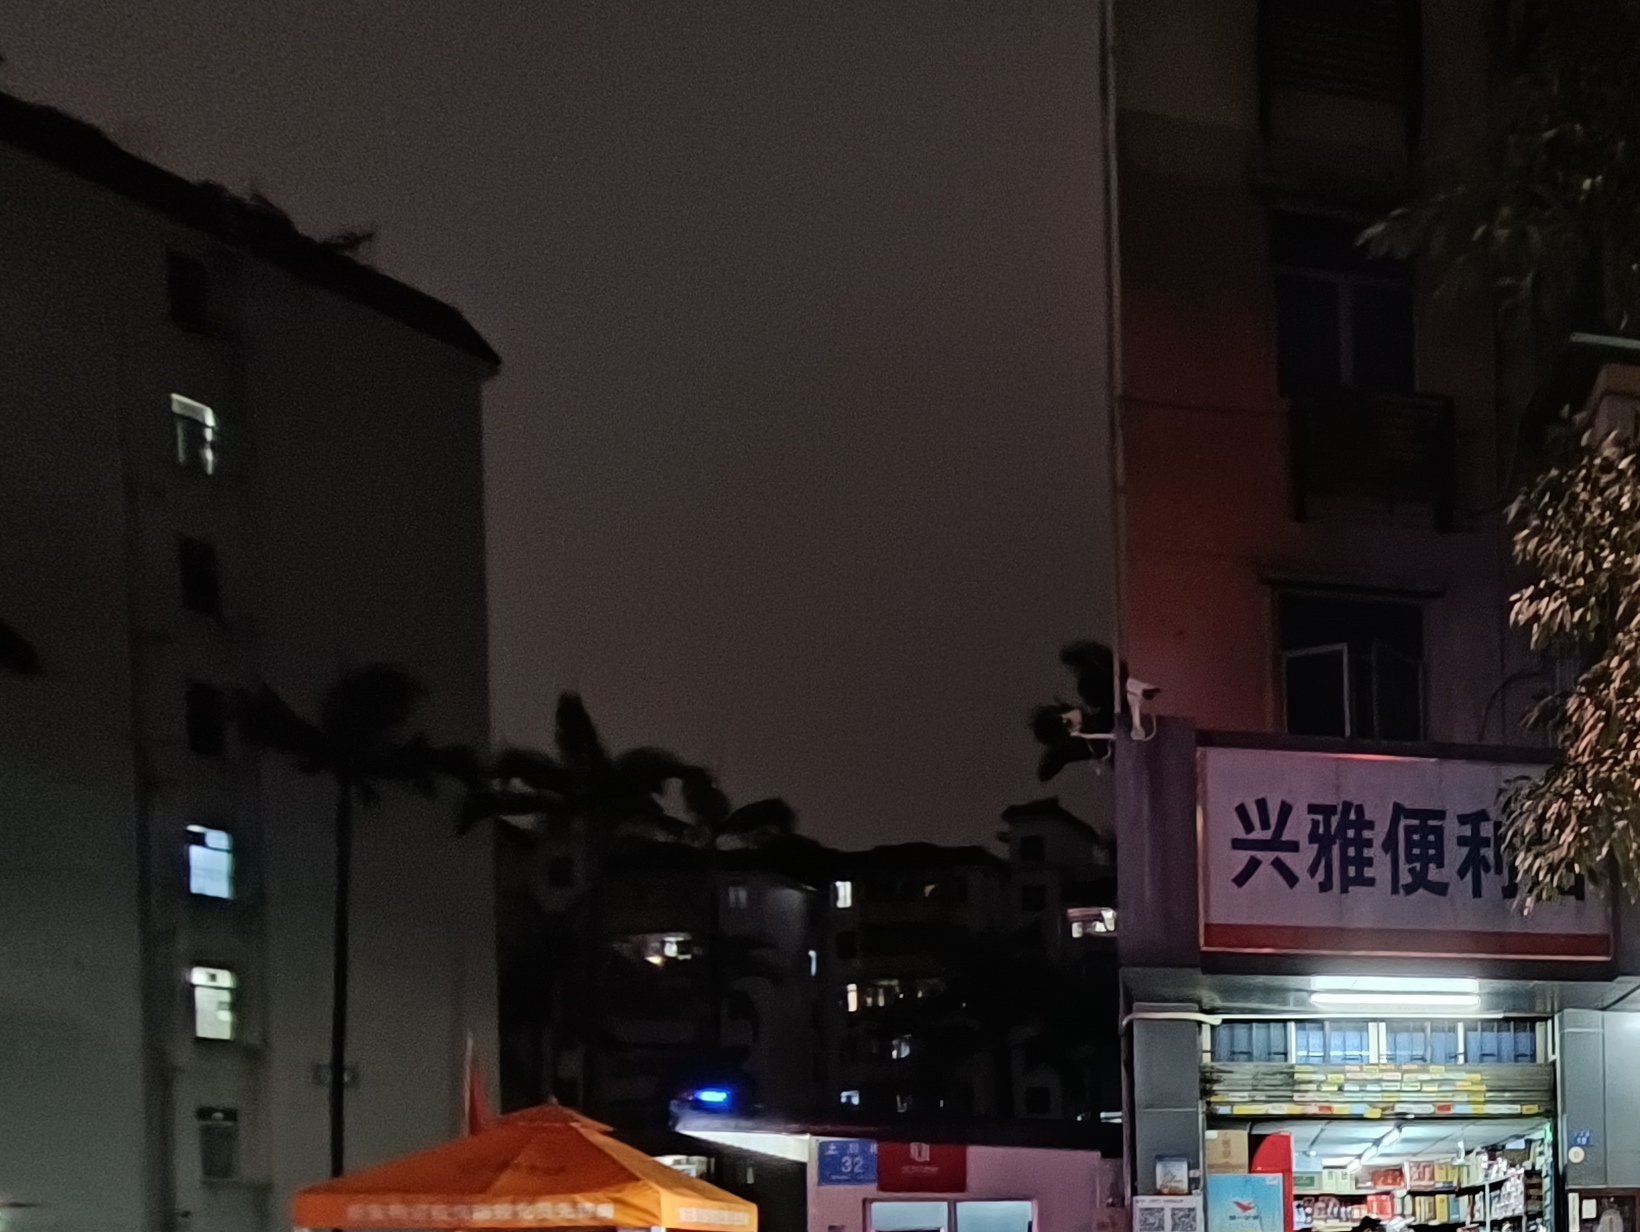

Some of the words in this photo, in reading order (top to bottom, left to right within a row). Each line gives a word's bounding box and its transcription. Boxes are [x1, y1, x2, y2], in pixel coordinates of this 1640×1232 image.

[1230, 797, 1586, 901] 兴雅便利
[841, 1155, 864, 1173] 32
